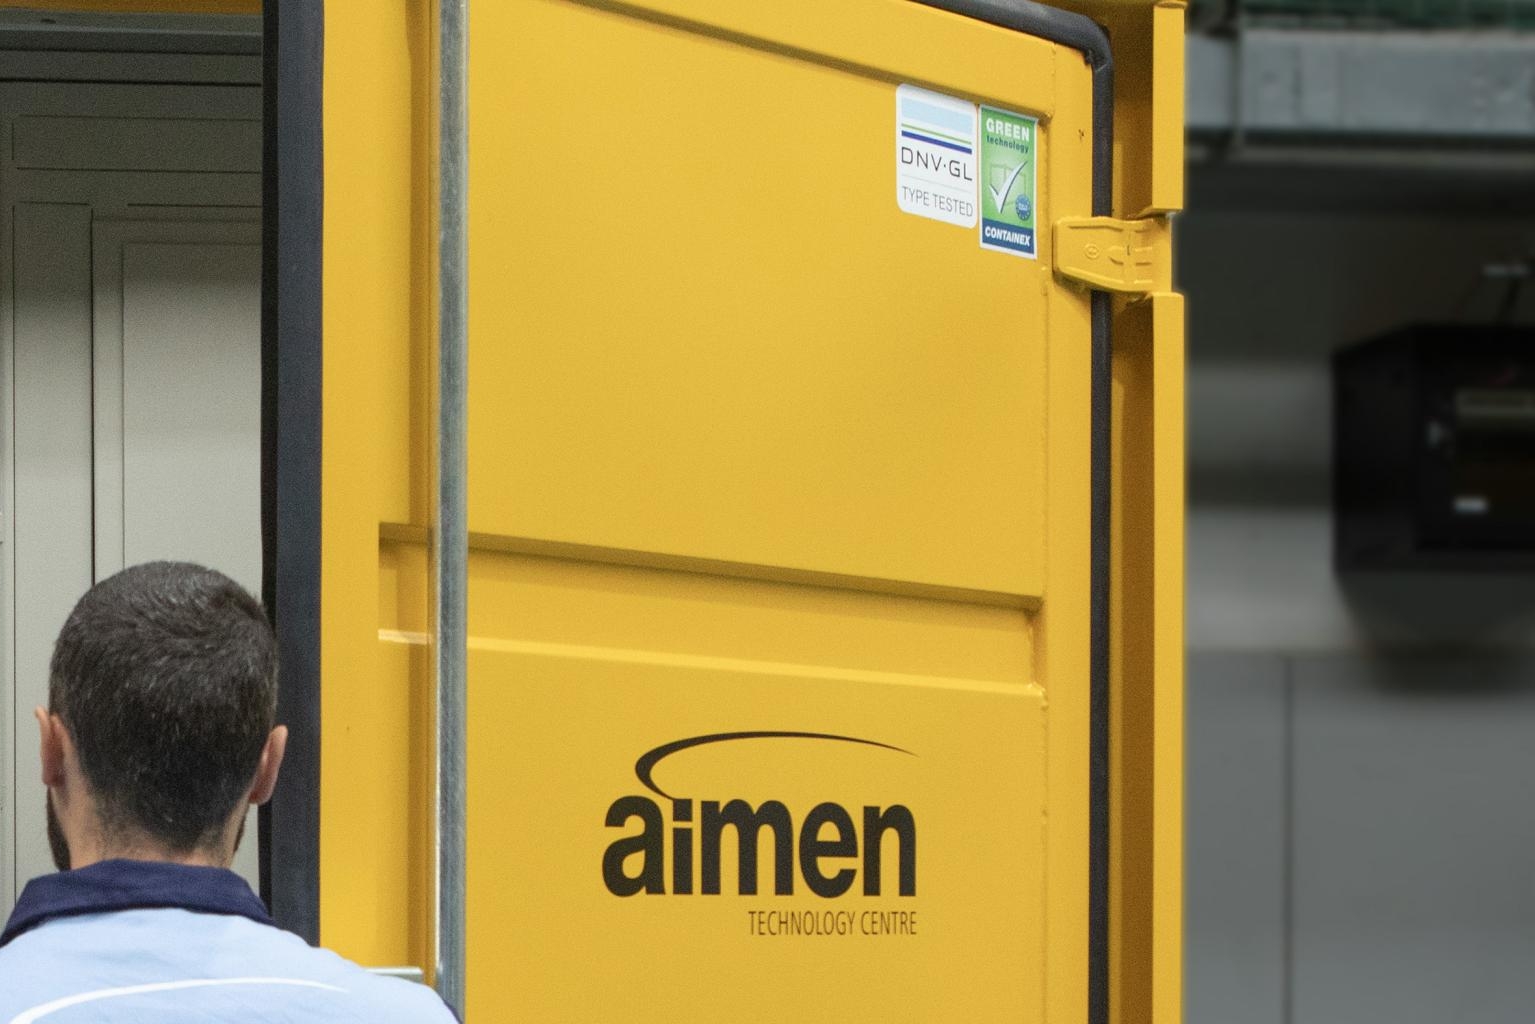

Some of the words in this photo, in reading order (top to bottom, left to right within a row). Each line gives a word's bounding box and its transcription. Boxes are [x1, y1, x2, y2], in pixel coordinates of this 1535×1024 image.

[985, 117, 1030, 142] GREEN
[986, 135, 1029, 154] technology
[902, 186, 930, 207] TYPE
[932, 192, 974, 218] TESTED
[984, 226, 1031, 247] CONTAINEX
[602, 795, 917, 899] aimen
[748, 909, 855, 937] TECHNOLOGY
[860, 910, 918, 936] CENTRE
